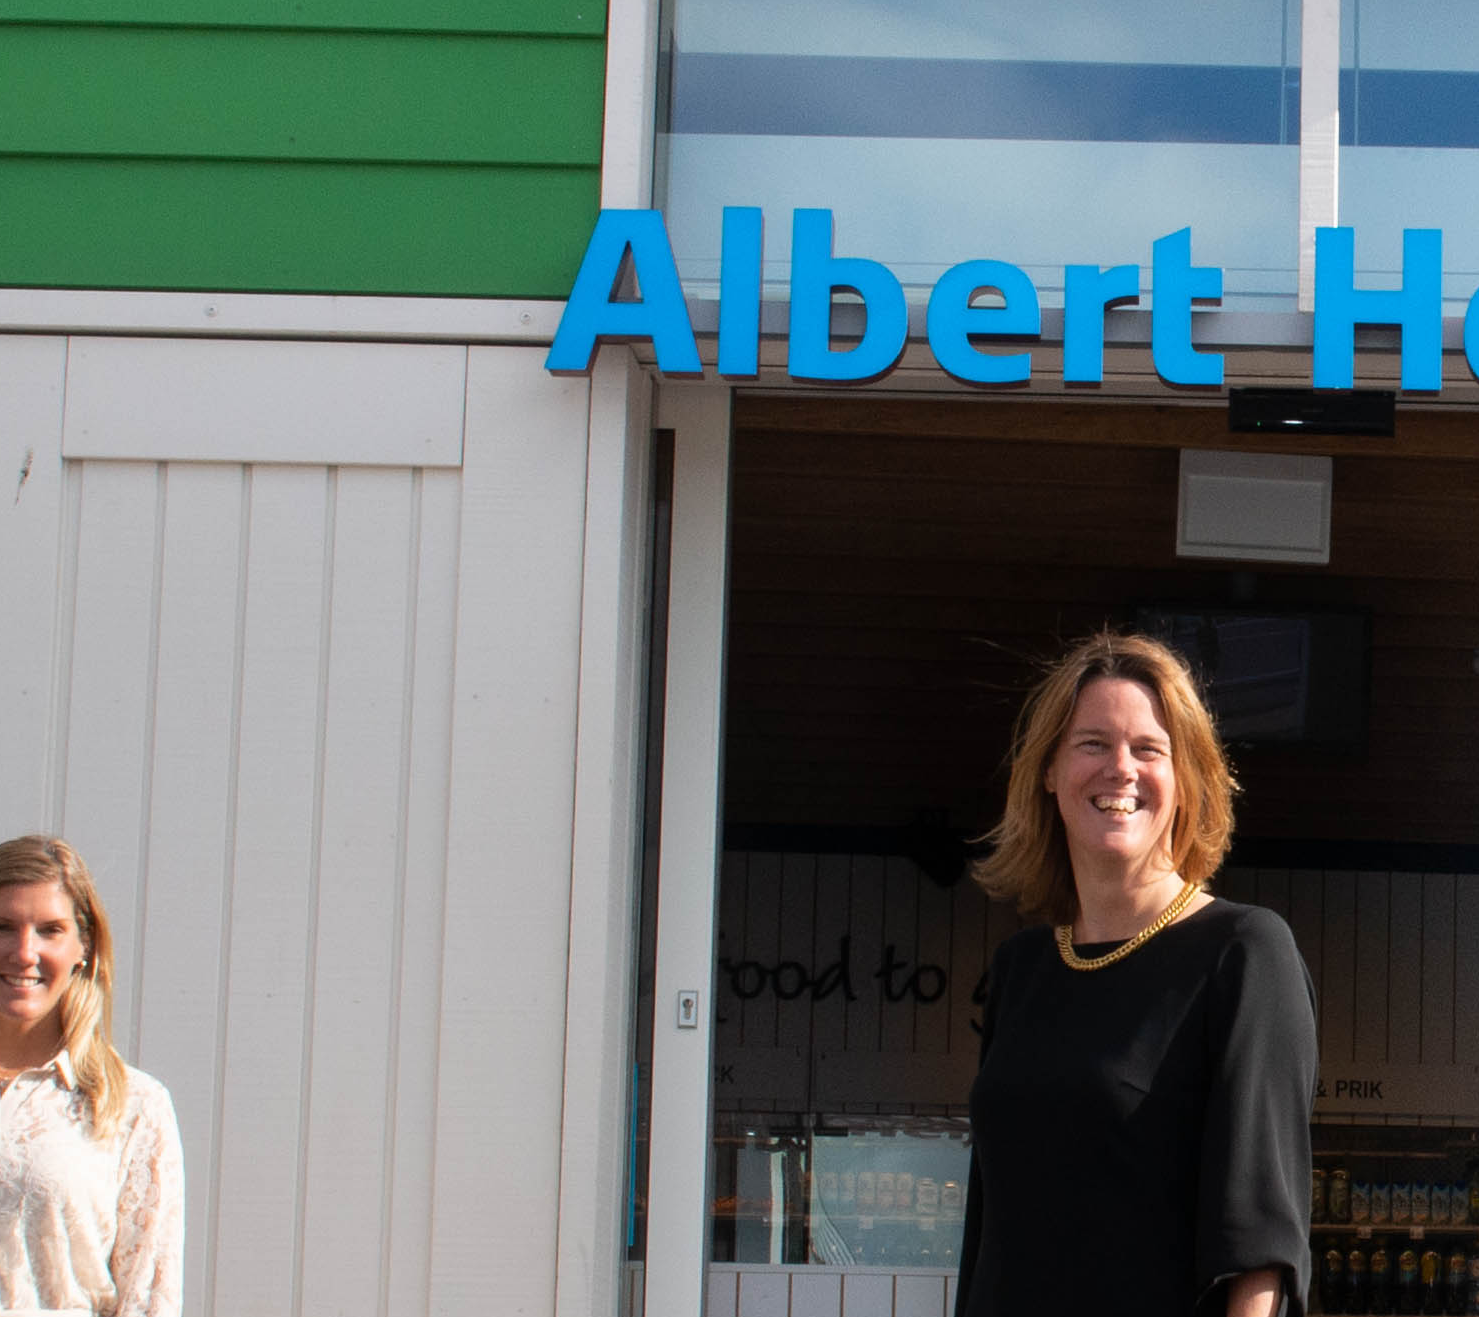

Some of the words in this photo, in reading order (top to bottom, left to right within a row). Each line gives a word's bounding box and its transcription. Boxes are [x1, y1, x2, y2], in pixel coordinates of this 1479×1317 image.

[546, 207, 1226, 388] Albert
[718, 933, 857, 1022] ood
[874, 944, 946, 1003] to
[1335, 1079, 1383, 1100] PRIK
